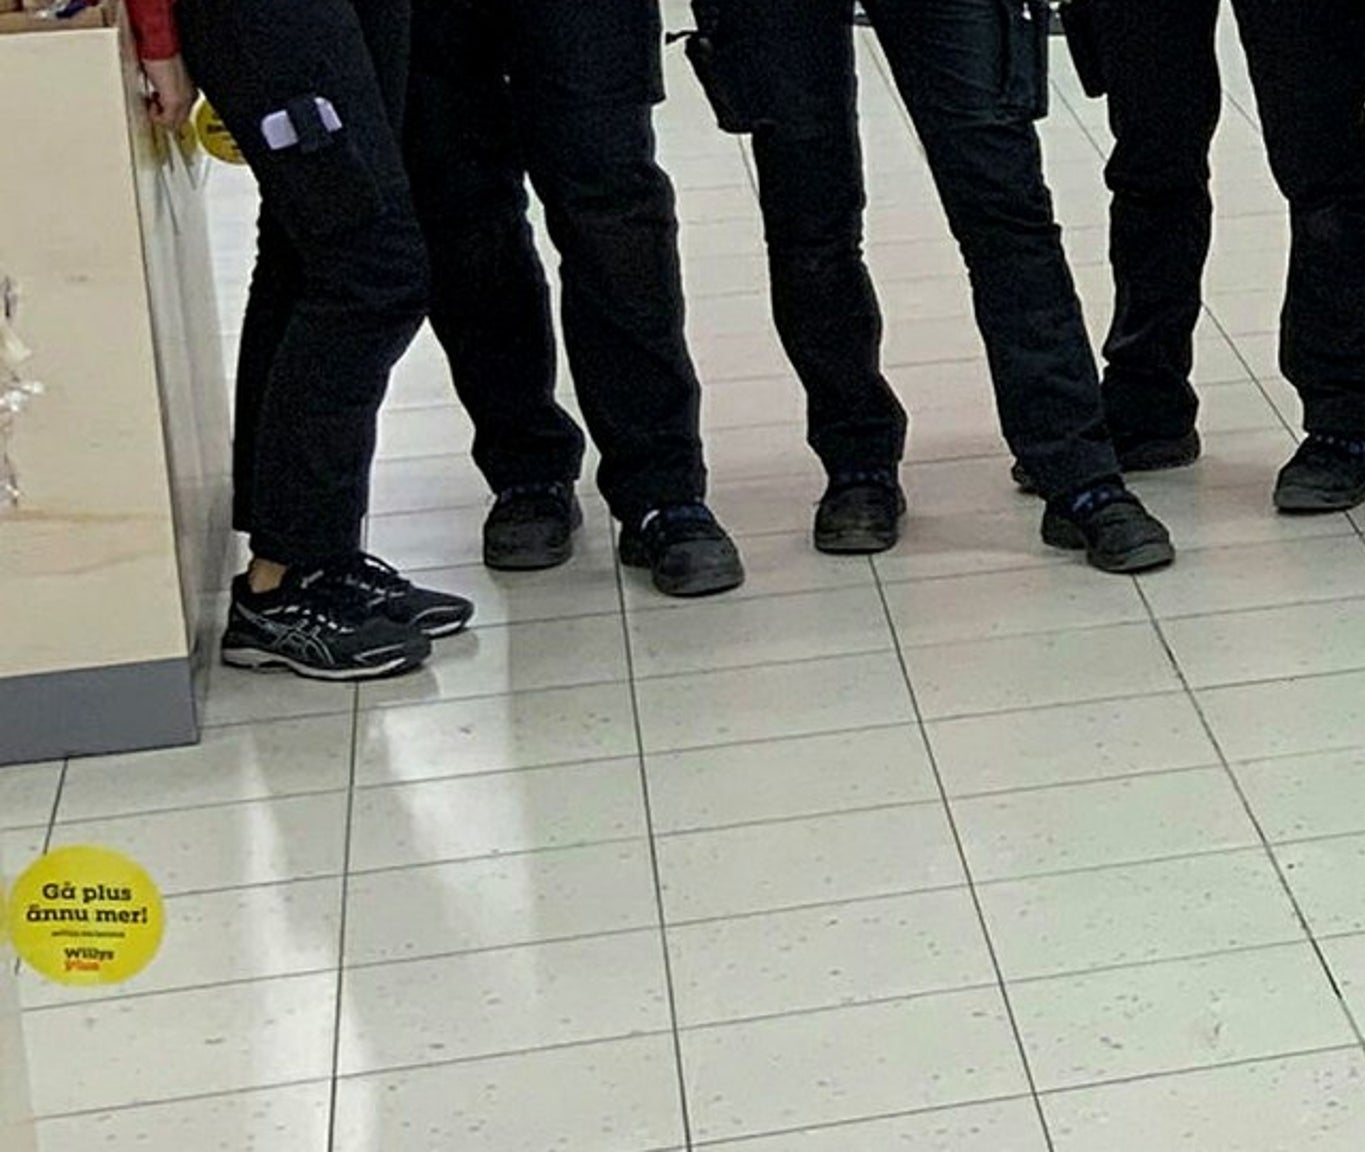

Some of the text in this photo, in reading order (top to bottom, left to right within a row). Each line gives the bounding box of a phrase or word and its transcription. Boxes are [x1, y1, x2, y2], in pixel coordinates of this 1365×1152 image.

[42, 881, 132, 903] Gå plus
[26, 904, 148, 924] ännu mer!
[64, 947, 114, 962] Willys
